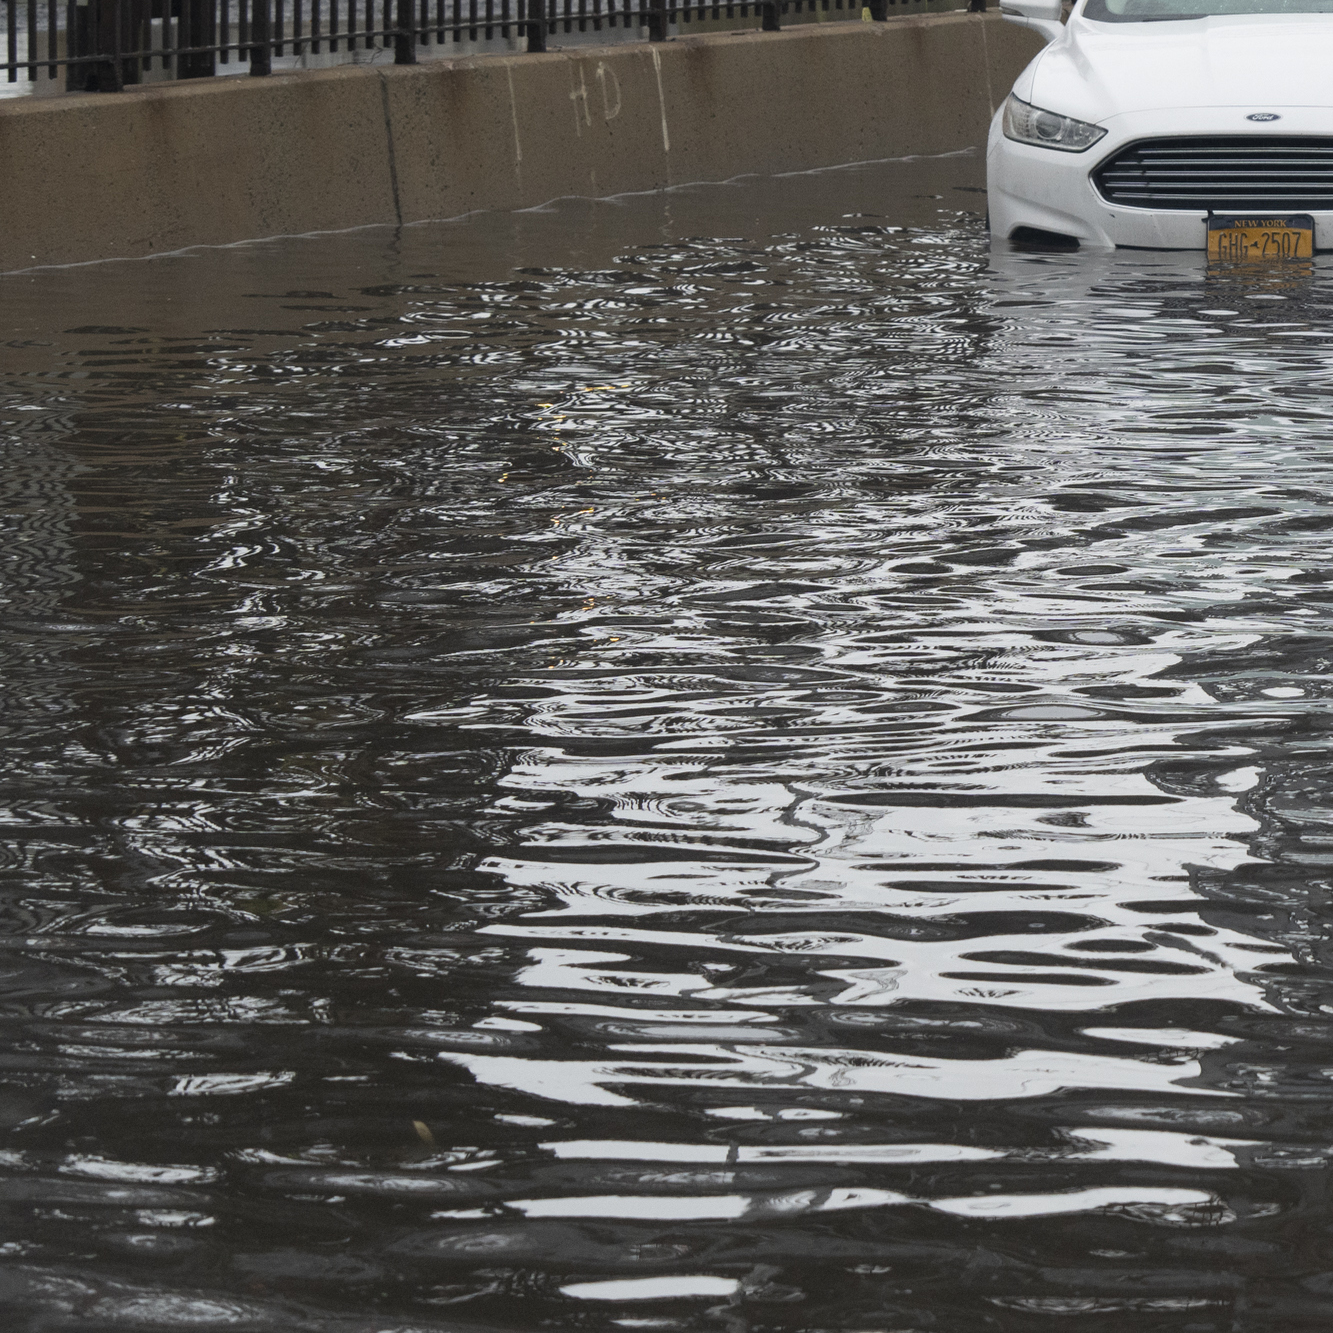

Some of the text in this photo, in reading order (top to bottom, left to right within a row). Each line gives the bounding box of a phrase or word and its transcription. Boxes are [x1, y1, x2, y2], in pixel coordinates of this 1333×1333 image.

[1234, 219, 1287, 228] NEW YORK
[1218, 231, 1301, 257] GHG 2507
